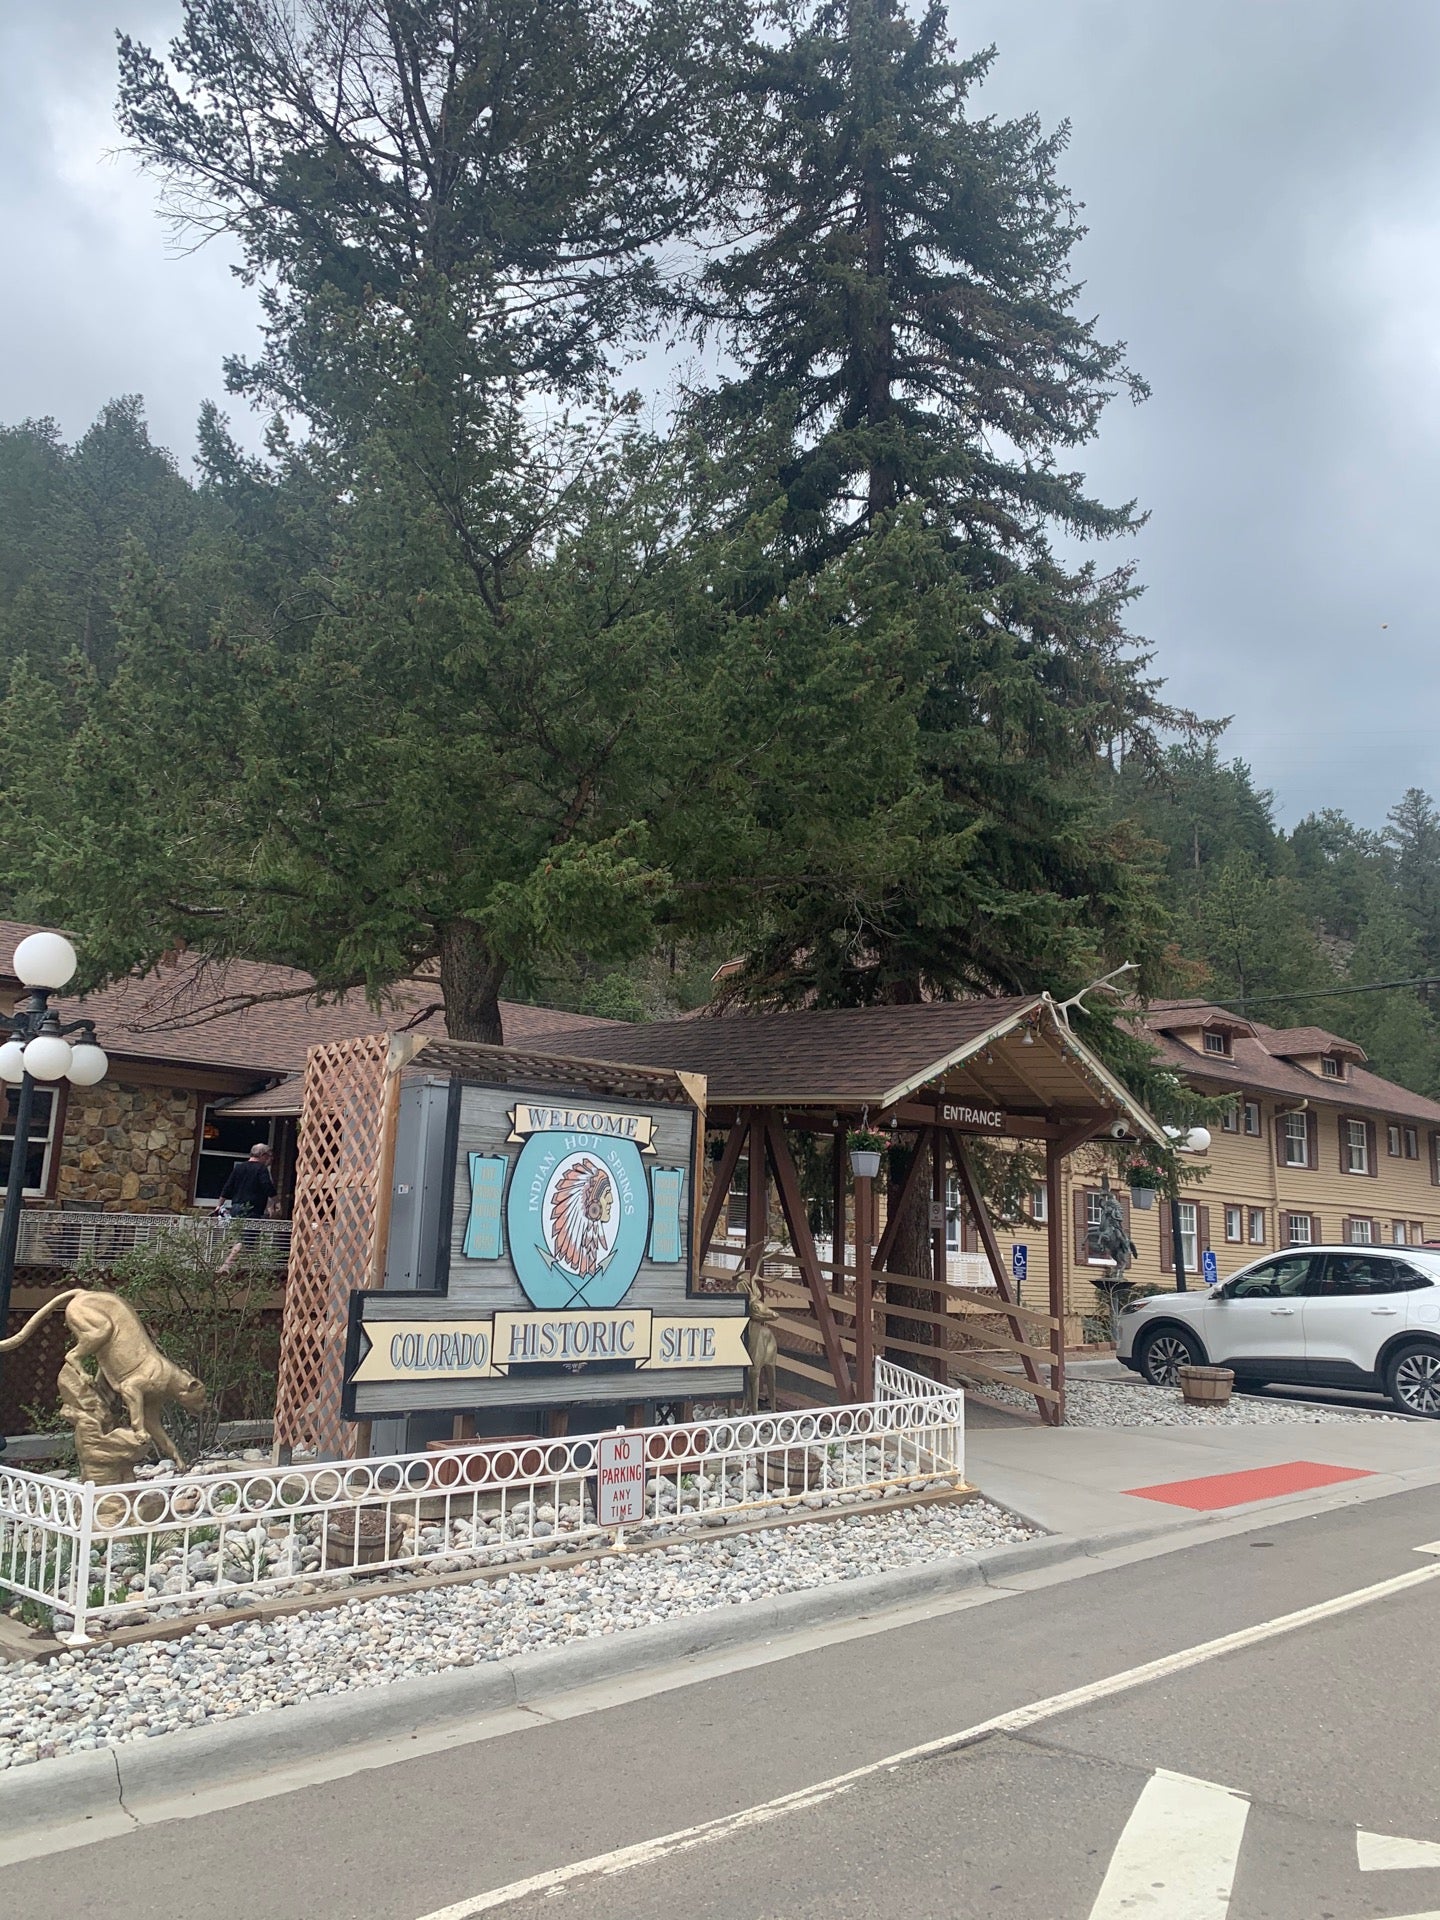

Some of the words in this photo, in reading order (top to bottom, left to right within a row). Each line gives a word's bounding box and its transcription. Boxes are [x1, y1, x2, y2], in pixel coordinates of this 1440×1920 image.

[527, 1108, 639, 1138] WELCOME
[943, 1104, 1002, 1127] ENTRANCE
[528, 1150, 556, 1212] INDIAN
[564, 1133, 603, 1150] HOT
[607, 1150, 634, 1216] SPRINGS
[390, 1331, 489, 1370] COLORADO
[508, 1320, 636, 1360] HISTORIC
[660, 1327, 716, 1361] SITE
[614, 1442, 631, 1461] NO
[602, 1463, 642, 1485] PARKING
[612, 1488, 631, 1502] ANY
[611, 1503, 633, 1517] TIME
